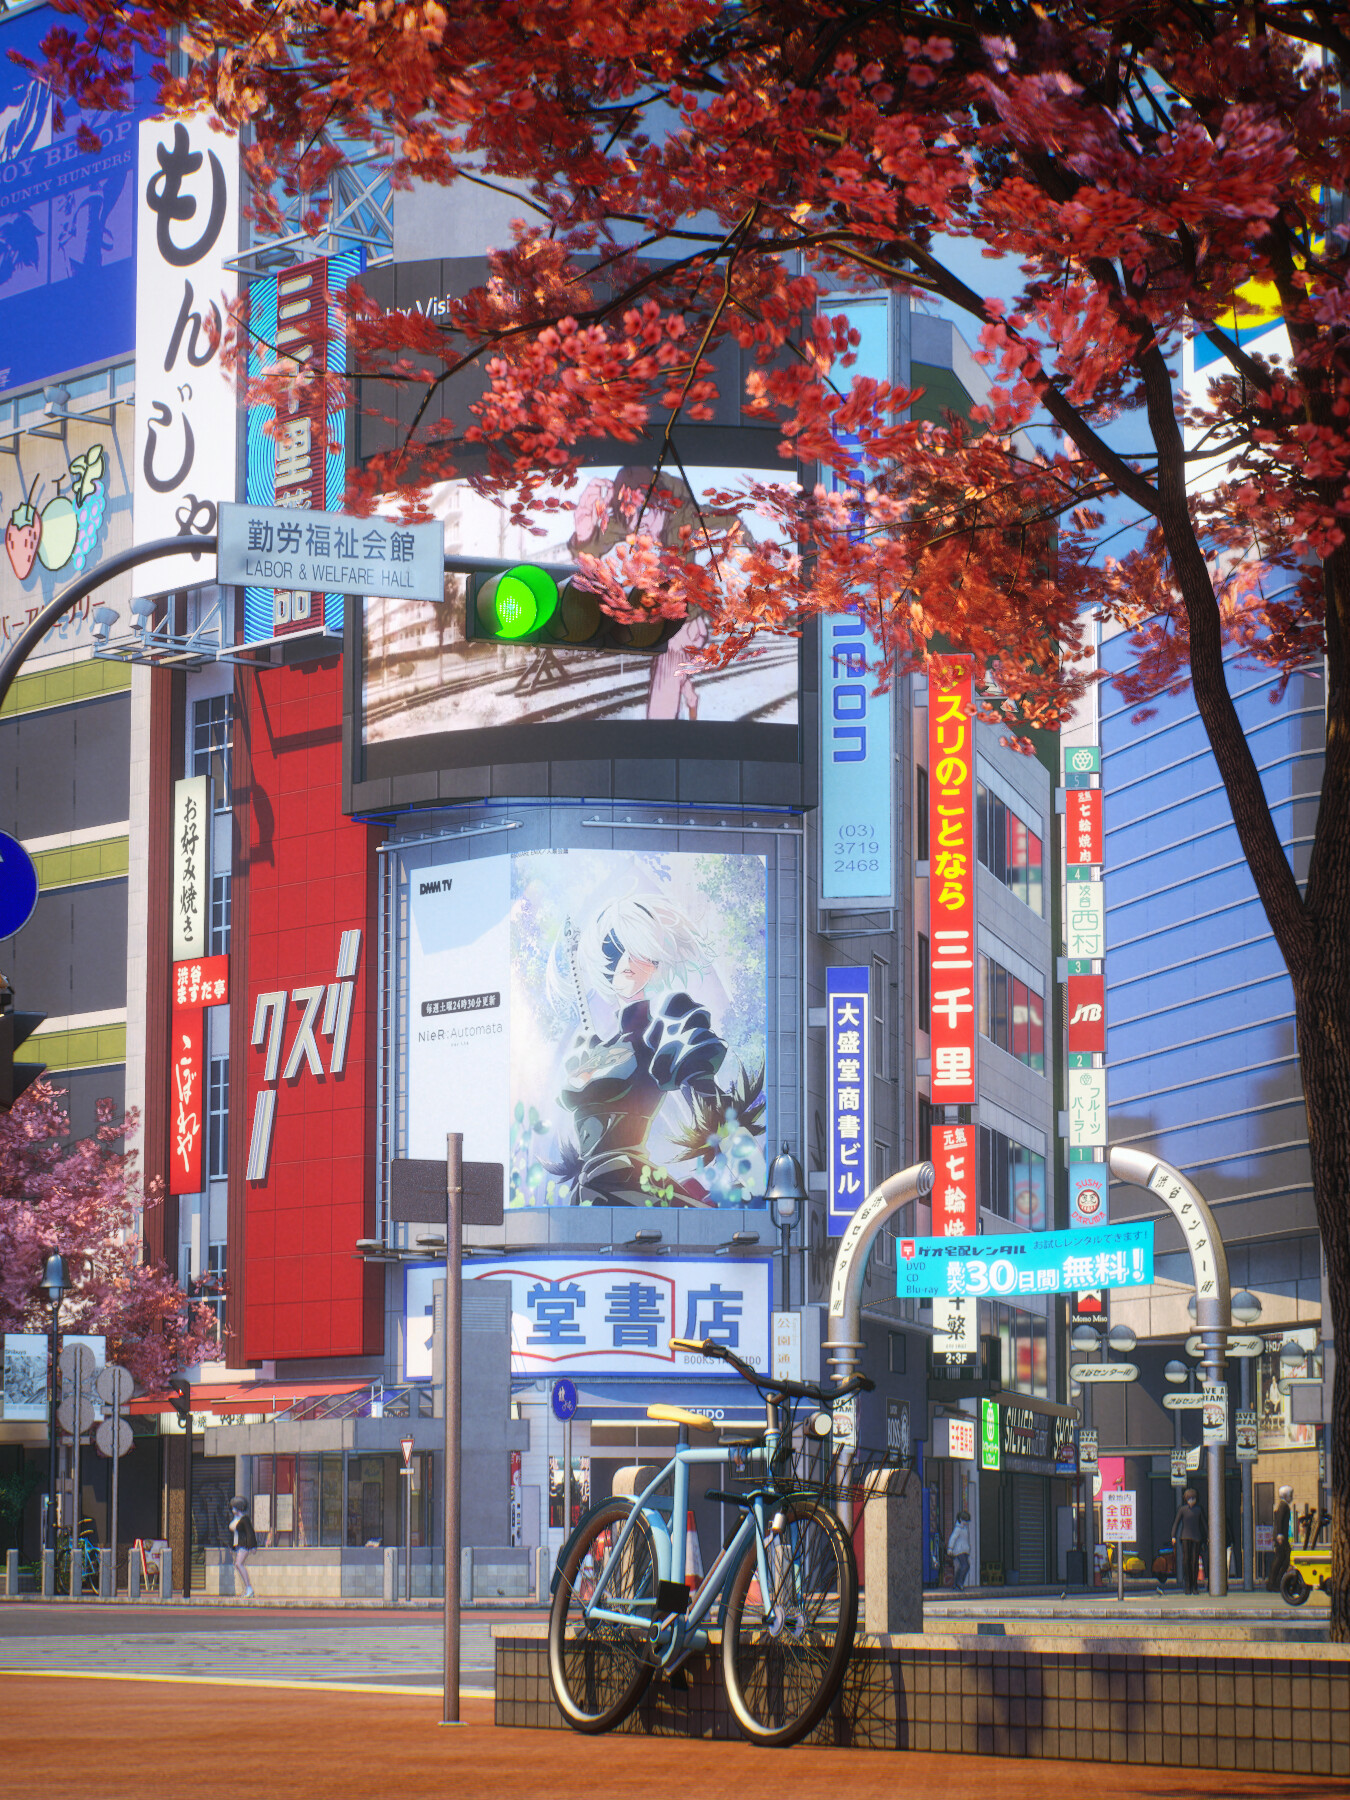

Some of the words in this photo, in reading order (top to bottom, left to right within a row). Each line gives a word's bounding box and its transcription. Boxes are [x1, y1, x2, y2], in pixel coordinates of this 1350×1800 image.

[44, 121, 132, 169] BEOP
[57, 150, 132, 187] HUNTERS
[248, 518, 415, 563] 勤労福祉会館
[246, 558, 293, 579] LABOR
[299, 563, 307, 580] &
[312, 564, 375, 586] WELFARE
[382, 570, 415, 588] HALL
[838, 824, 875, 838] (03)
[1078, 804, 1092, 863] 七輪焼肉
[834, 842, 879, 854] 3719
[180, 796, 200, 942] お好み焼き
[834, 860, 879, 872] 2468
[1074, 869, 1081, 880] 4
[420, 881, 441, 895] DMM
[442, 879, 452, 891] TV
[1072, 910, 1101, 955] 西村
[1075, 961, 1081, 973] 3
[177, 965, 201, 987] 渋谷
[177, 979, 225, 1005] ますだ亭
[932, 930, 973, 1086] 三千里
[1070, 1004, 1102, 1025] JTB
[418, 1022, 503, 1042] NieR:Automata
[1076, 1055, 1083, 1067] 2
[837, 1002, 861, 1194] 大盛堂商書ビル
[1088, 1087, 1100, 1135] フルーツ
[1079, 1149, 1084, 1160] 1
[1075, 1179, 1103, 1190] SUSHI
[1071, 1211, 1106, 1225] DARUMA
[918, 1245, 1027, 1257] ゲオ宅配レンタル
[906, 1262, 926, 1271] DVD
[906, 1274, 919, 1282] CD
[906, 1285, 939, 1295] Blu-ray
[684, 1355, 714, 1365] BOOKS
[1106, 1504, 1132, 1517] 全面
[1106, 1518, 1132, 1530] 禁煙
